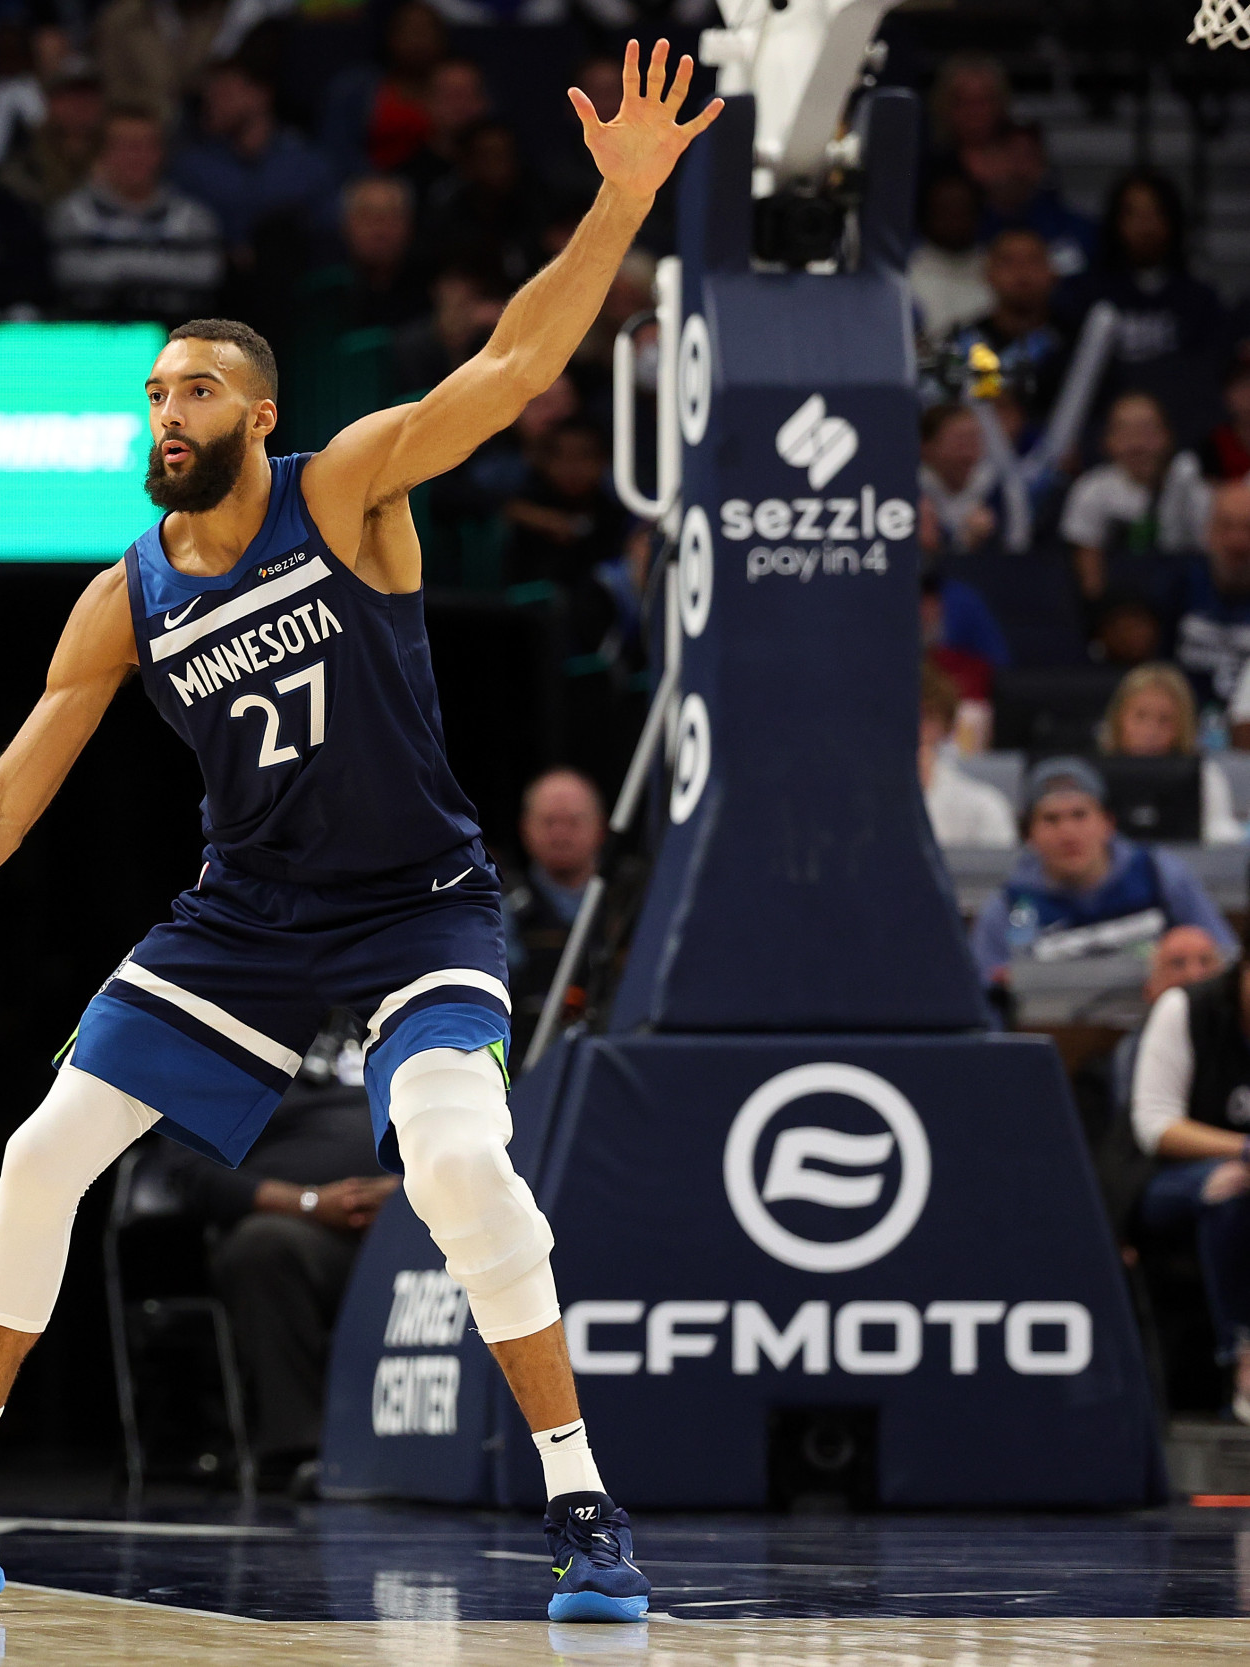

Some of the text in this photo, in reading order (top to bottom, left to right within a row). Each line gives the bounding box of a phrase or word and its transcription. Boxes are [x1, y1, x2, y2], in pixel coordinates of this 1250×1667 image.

[720, 484, 915, 541] sezzle
[267, 550, 306, 576] sezzle
[747, 539, 888, 584] pay in 4
[168, 598, 343, 708] MINNESOTA
[229, 659, 325, 768] 27
[563, 1300, 1093, 1375] CFMOTO
[372, 1355, 461, 1437] CENTER
